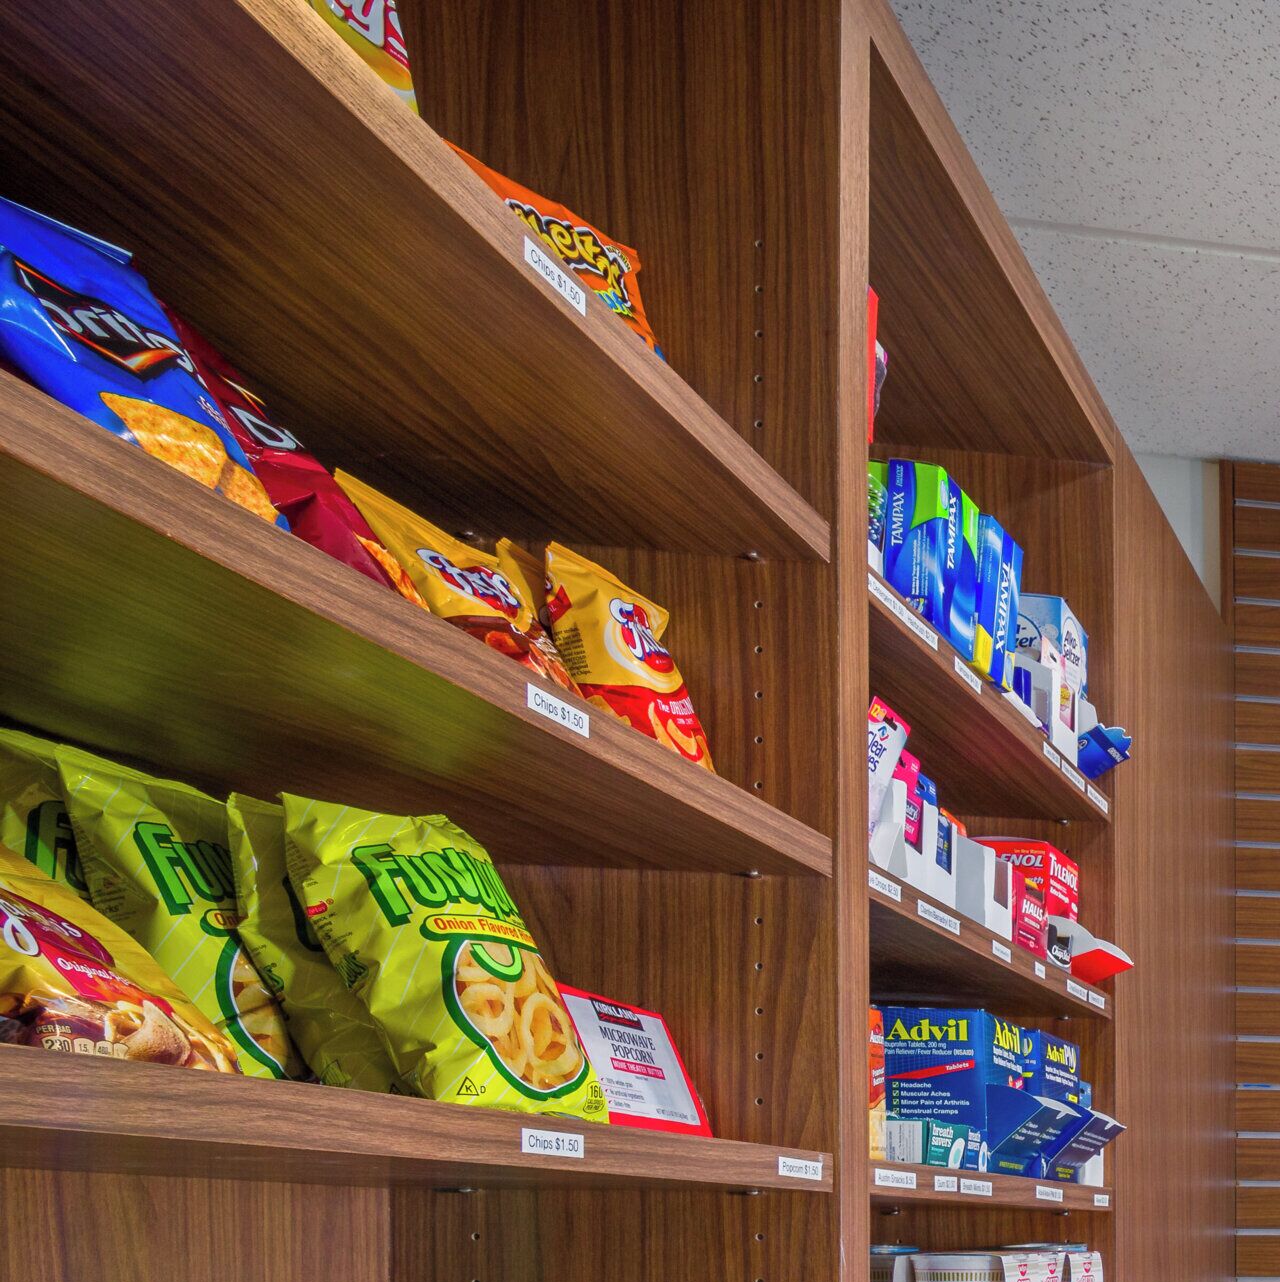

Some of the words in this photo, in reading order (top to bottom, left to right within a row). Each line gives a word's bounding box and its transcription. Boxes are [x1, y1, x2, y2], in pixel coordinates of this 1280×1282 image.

[530, 249, 556, 282] Chips
[557, 273, 581, 305] $1.50
[891, 491, 905, 547] TAMPAX
[995, 562, 1015, 655] TAMPAX
[1063, 630, 1078, 648] Alka-
[1063, 650, 1081, 668] Seltzer
[533, 691, 559, 718] Chips
[560, 705, 584, 730] $1.50
[1050, 852, 1078, 892] TYLENOL
[1022, 899, 1043, 921] HALLS
[433, 917, 475, 931] Onion
[480, 920, 518, 938] Flavored
[594, 1000, 639, 1022] KIRKLAND
[599, 1026, 656, 1051] MICROWAVE
[885, 1018, 969, 1042] Advil
[993, 1018, 1022, 1056] Advil
[611, 1043, 655, 1065] POPCORN
[627, 1062, 647, 1075] THEATER
[945, 1062, 970, 1072] Tablets
[933, 1108, 959, 1116] Cramps
[943, 1099, 970, 1107] Arthritis
[932, 1123, 954, 1139] breath
[528, 1134, 553, 1153] Chips
[555, 1137, 579, 1153] $1.50
[931, 1137, 952, 1148] savers
[782, 1161, 804, 1175] Popcorn
[804, 1164, 819, 1176] $1.50
